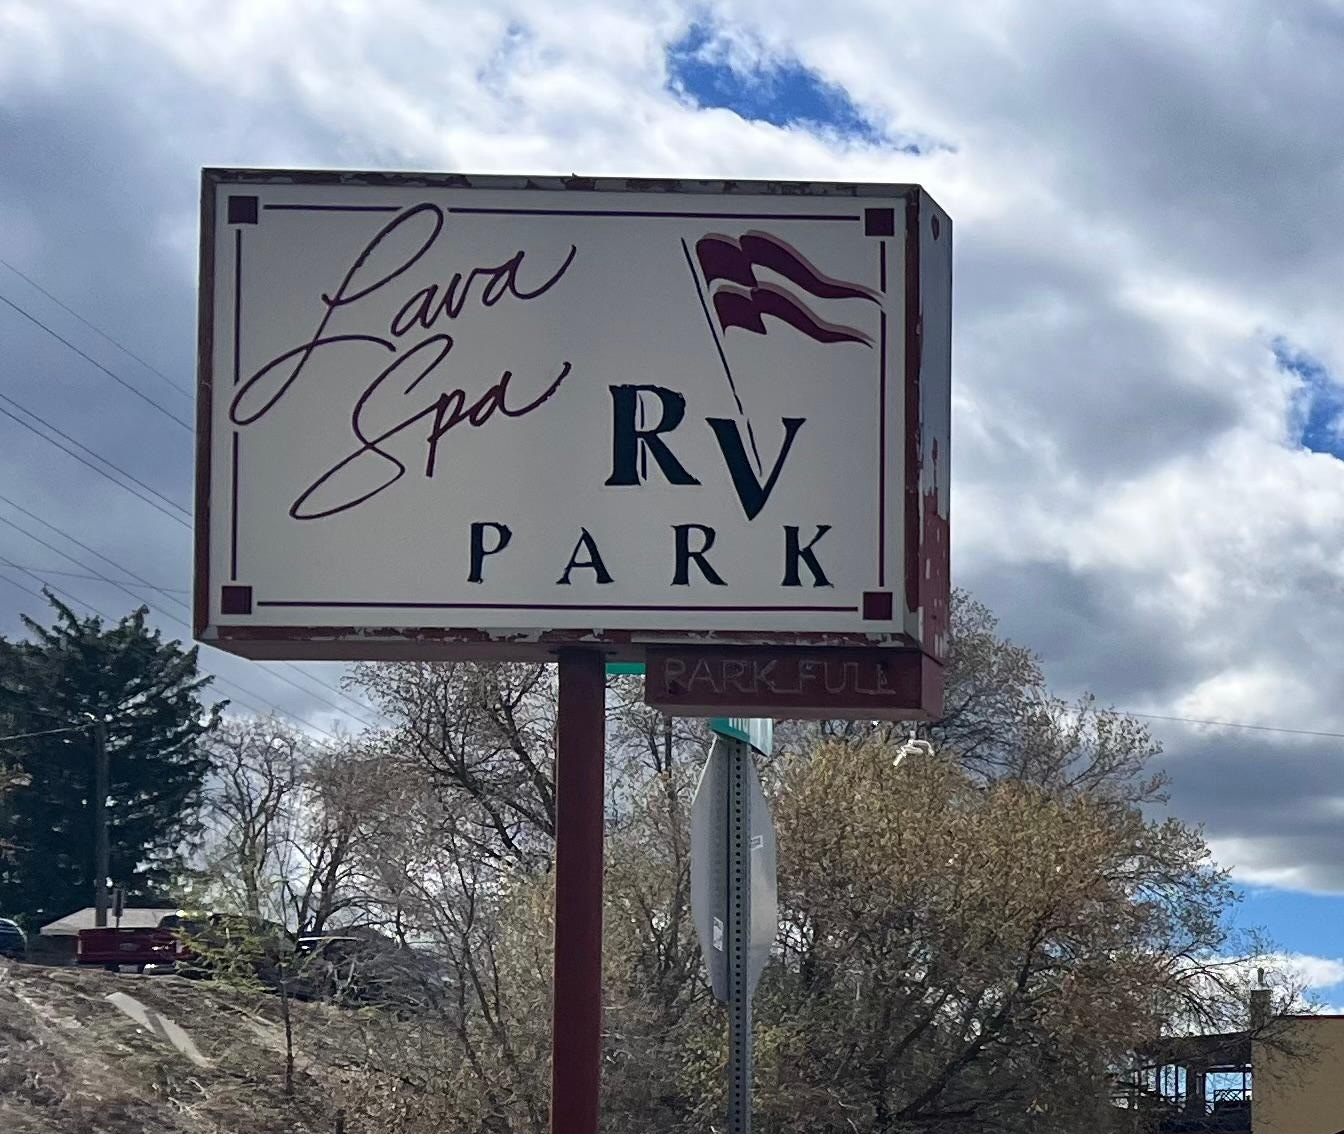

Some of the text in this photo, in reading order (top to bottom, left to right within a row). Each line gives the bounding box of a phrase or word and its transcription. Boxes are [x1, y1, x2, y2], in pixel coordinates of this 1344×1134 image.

[228, 202, 577, 426] Lava
[289, 333, 572, 520] Spa
[604, 383, 807, 522] RV
[466, 521, 835, 589] PARK
[664, 657, 897, 696] PARK FULL
